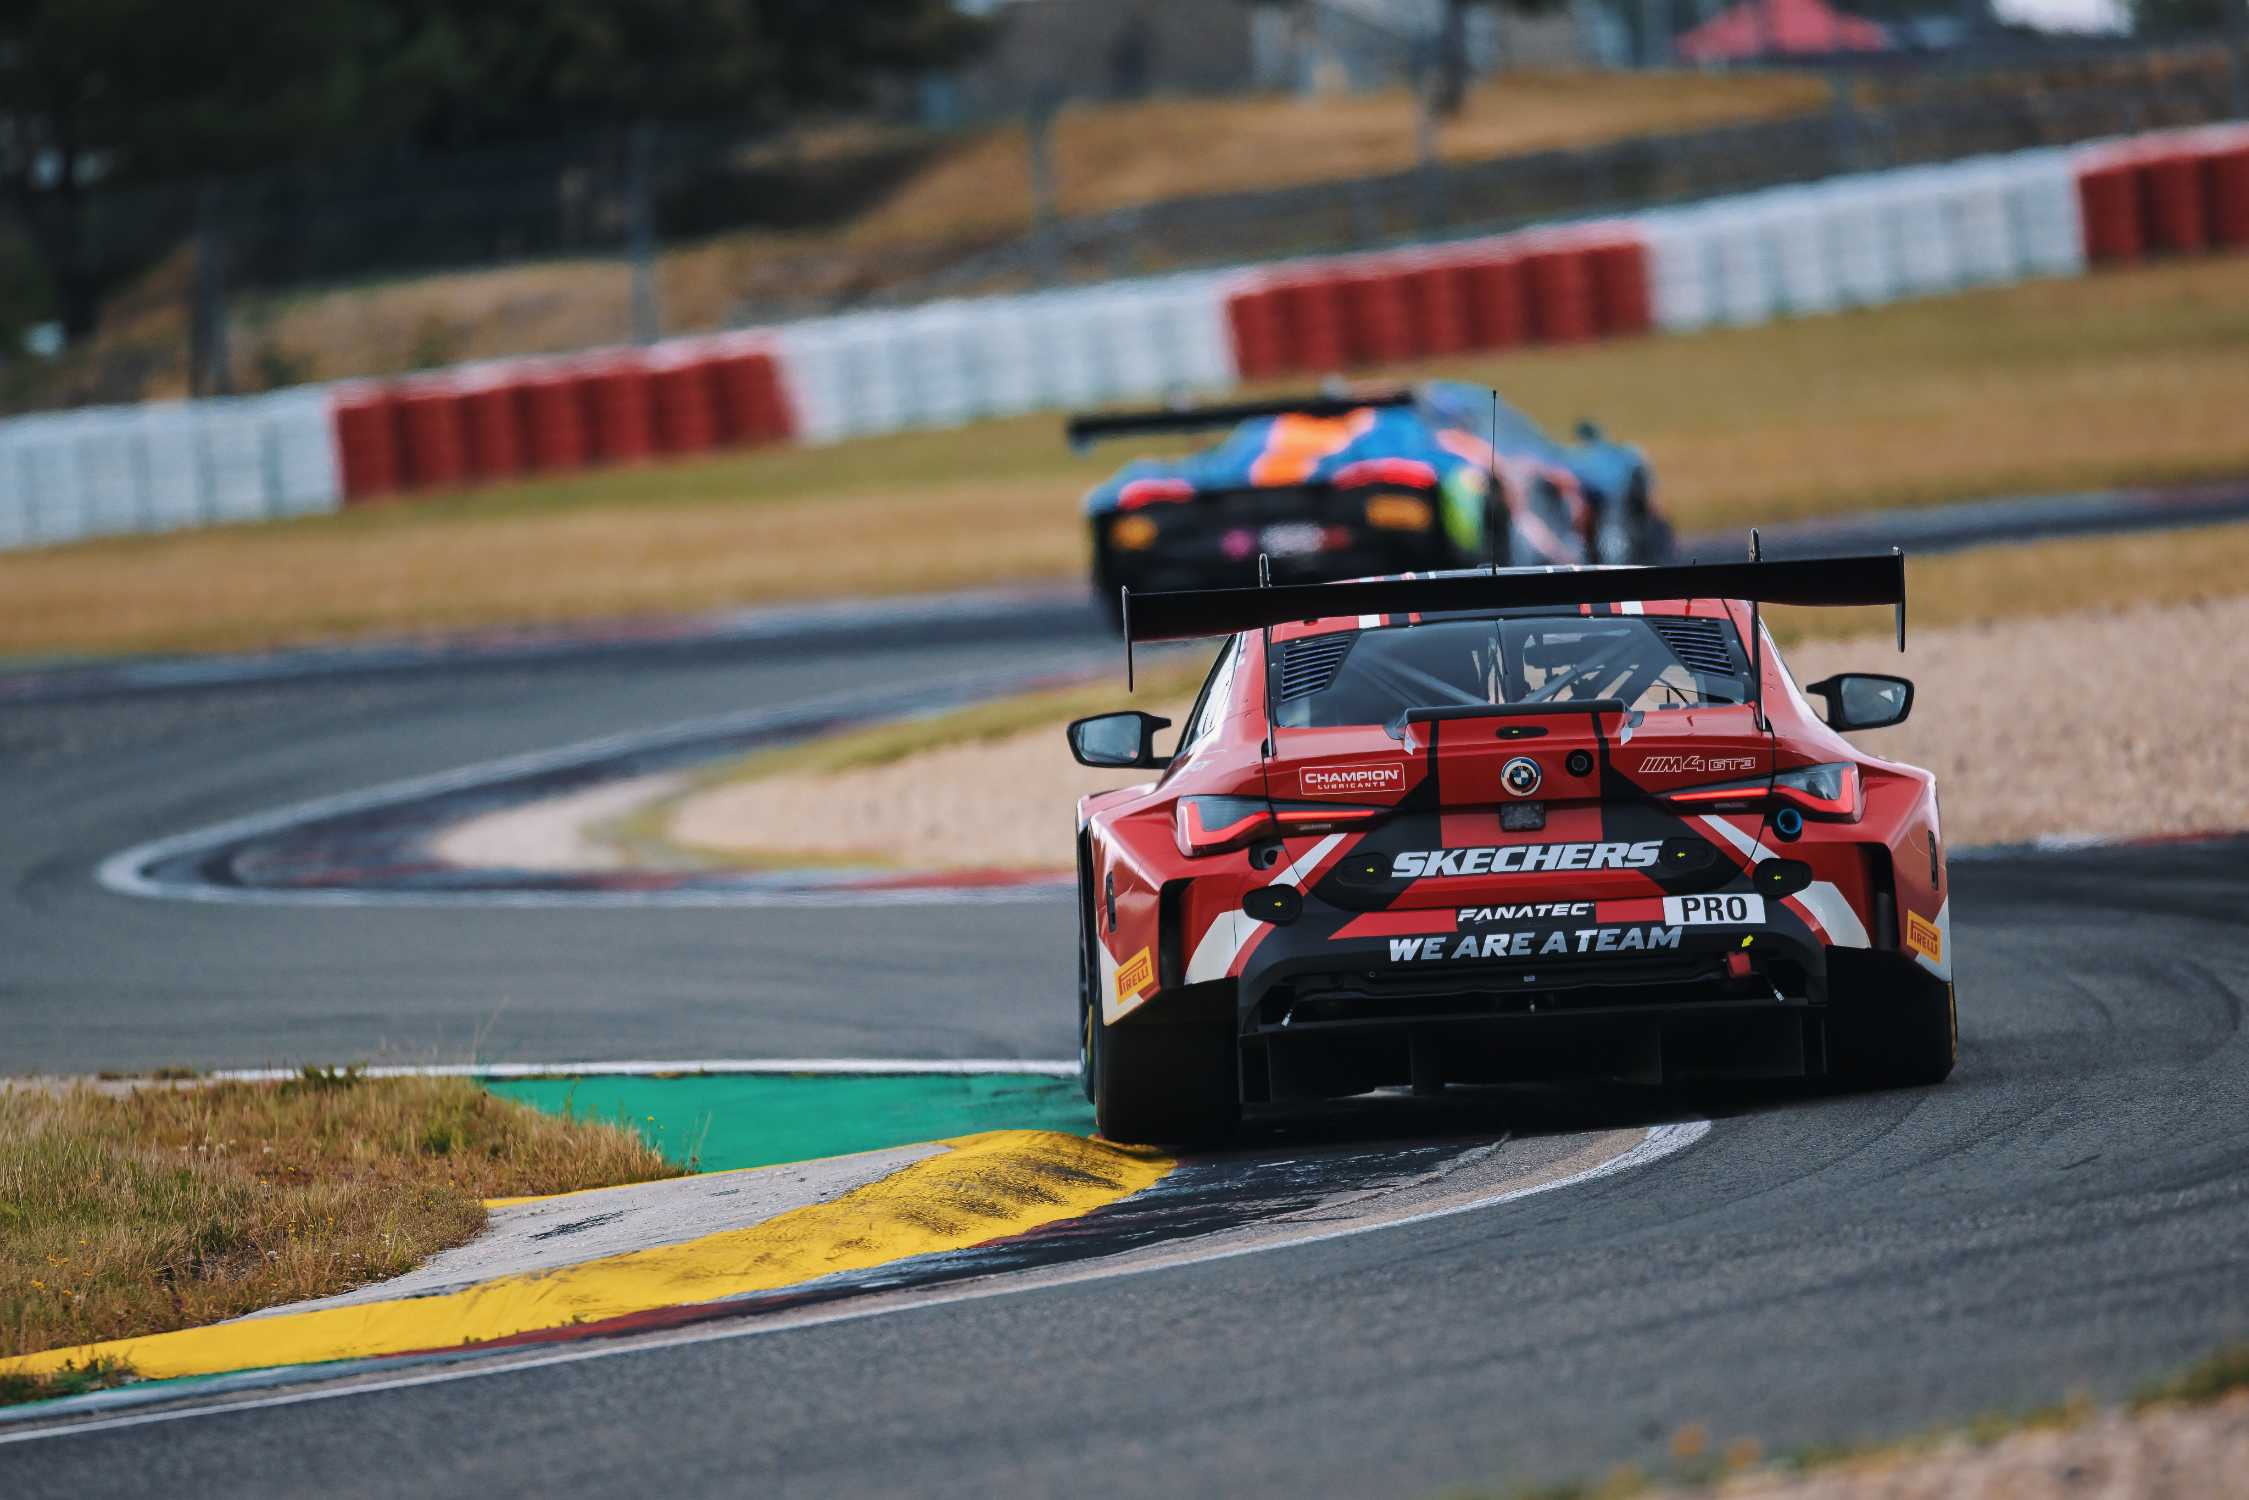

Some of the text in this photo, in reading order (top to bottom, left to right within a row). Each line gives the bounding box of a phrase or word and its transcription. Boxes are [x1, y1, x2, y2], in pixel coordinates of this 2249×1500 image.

[1305, 770, 1399, 784] CHAMPION
[1318, 781, 1386, 790] LUBRICANTS
[1391, 840, 1663, 878] SKECHERS
[1457, 902, 1594, 923] FANATEC
[1681, 895, 1748, 923] PRO
[1389, 926, 1683, 962] WE ARE A TEAM
